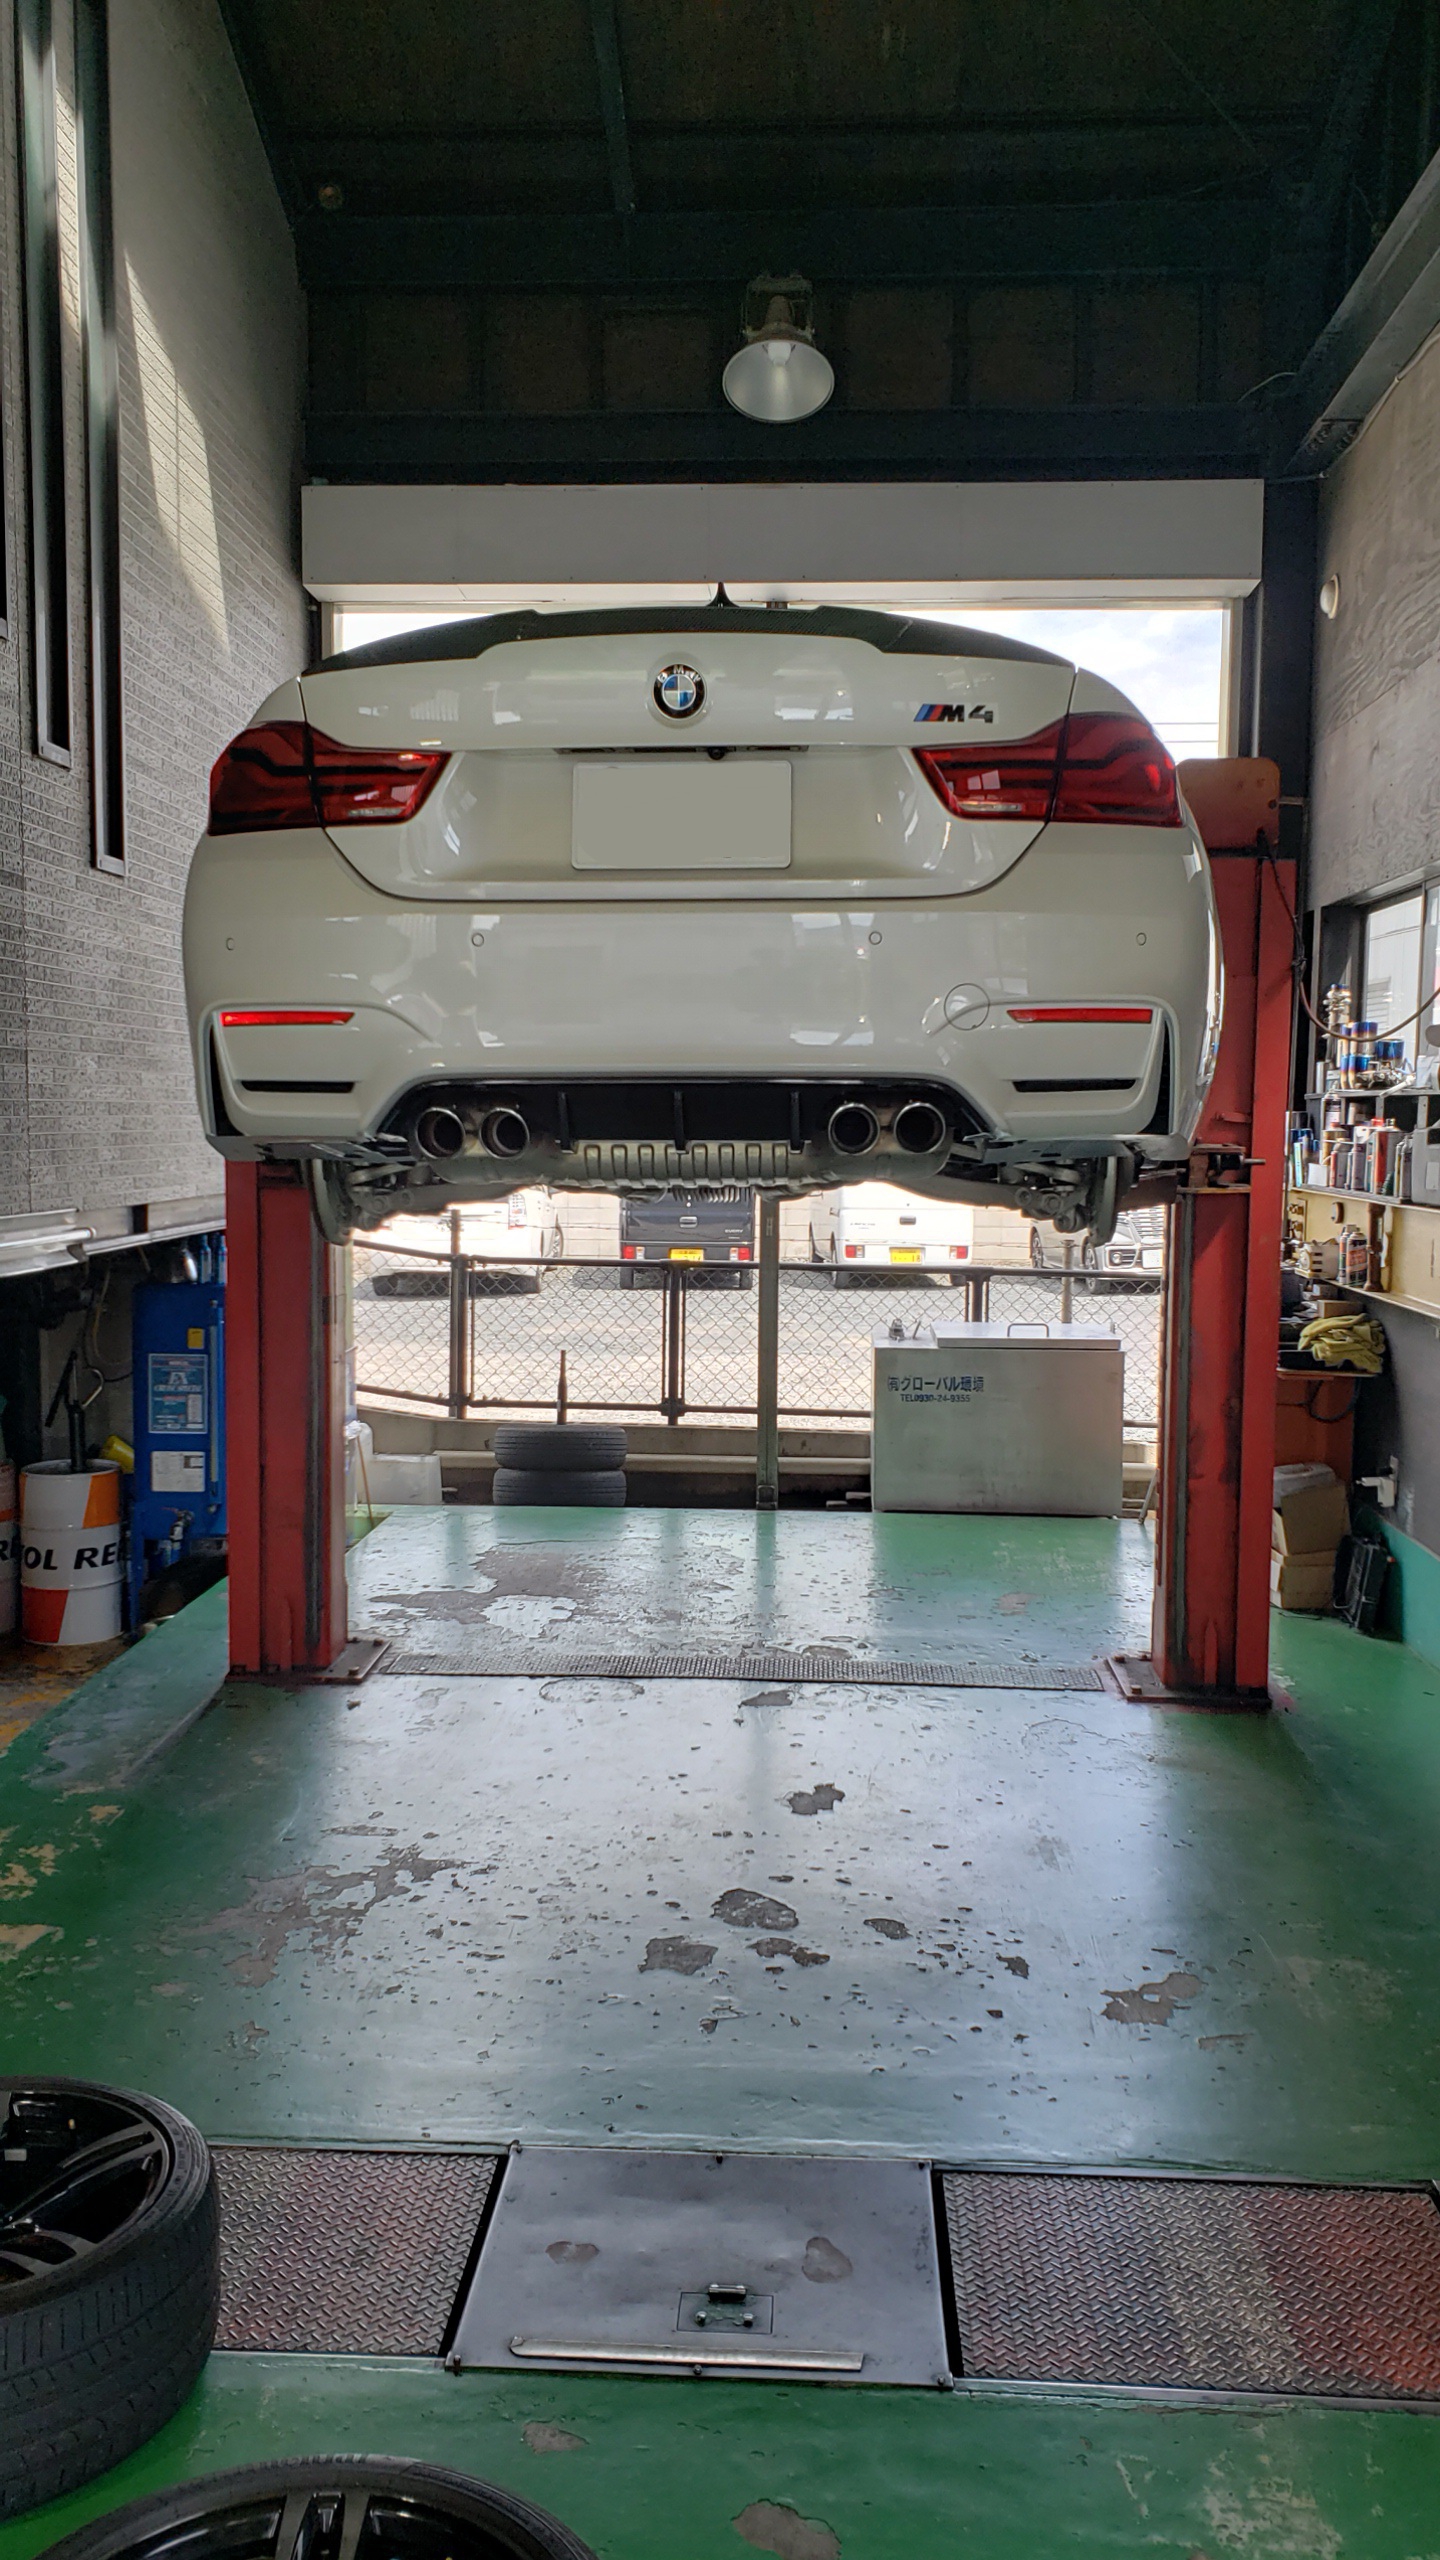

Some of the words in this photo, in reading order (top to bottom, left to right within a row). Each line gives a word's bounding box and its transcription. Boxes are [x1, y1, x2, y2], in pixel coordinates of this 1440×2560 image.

[657, 664, 702, 683] BMW
[935, 703, 994, 723] M4
[21, 1545, 58, 1570] OL
